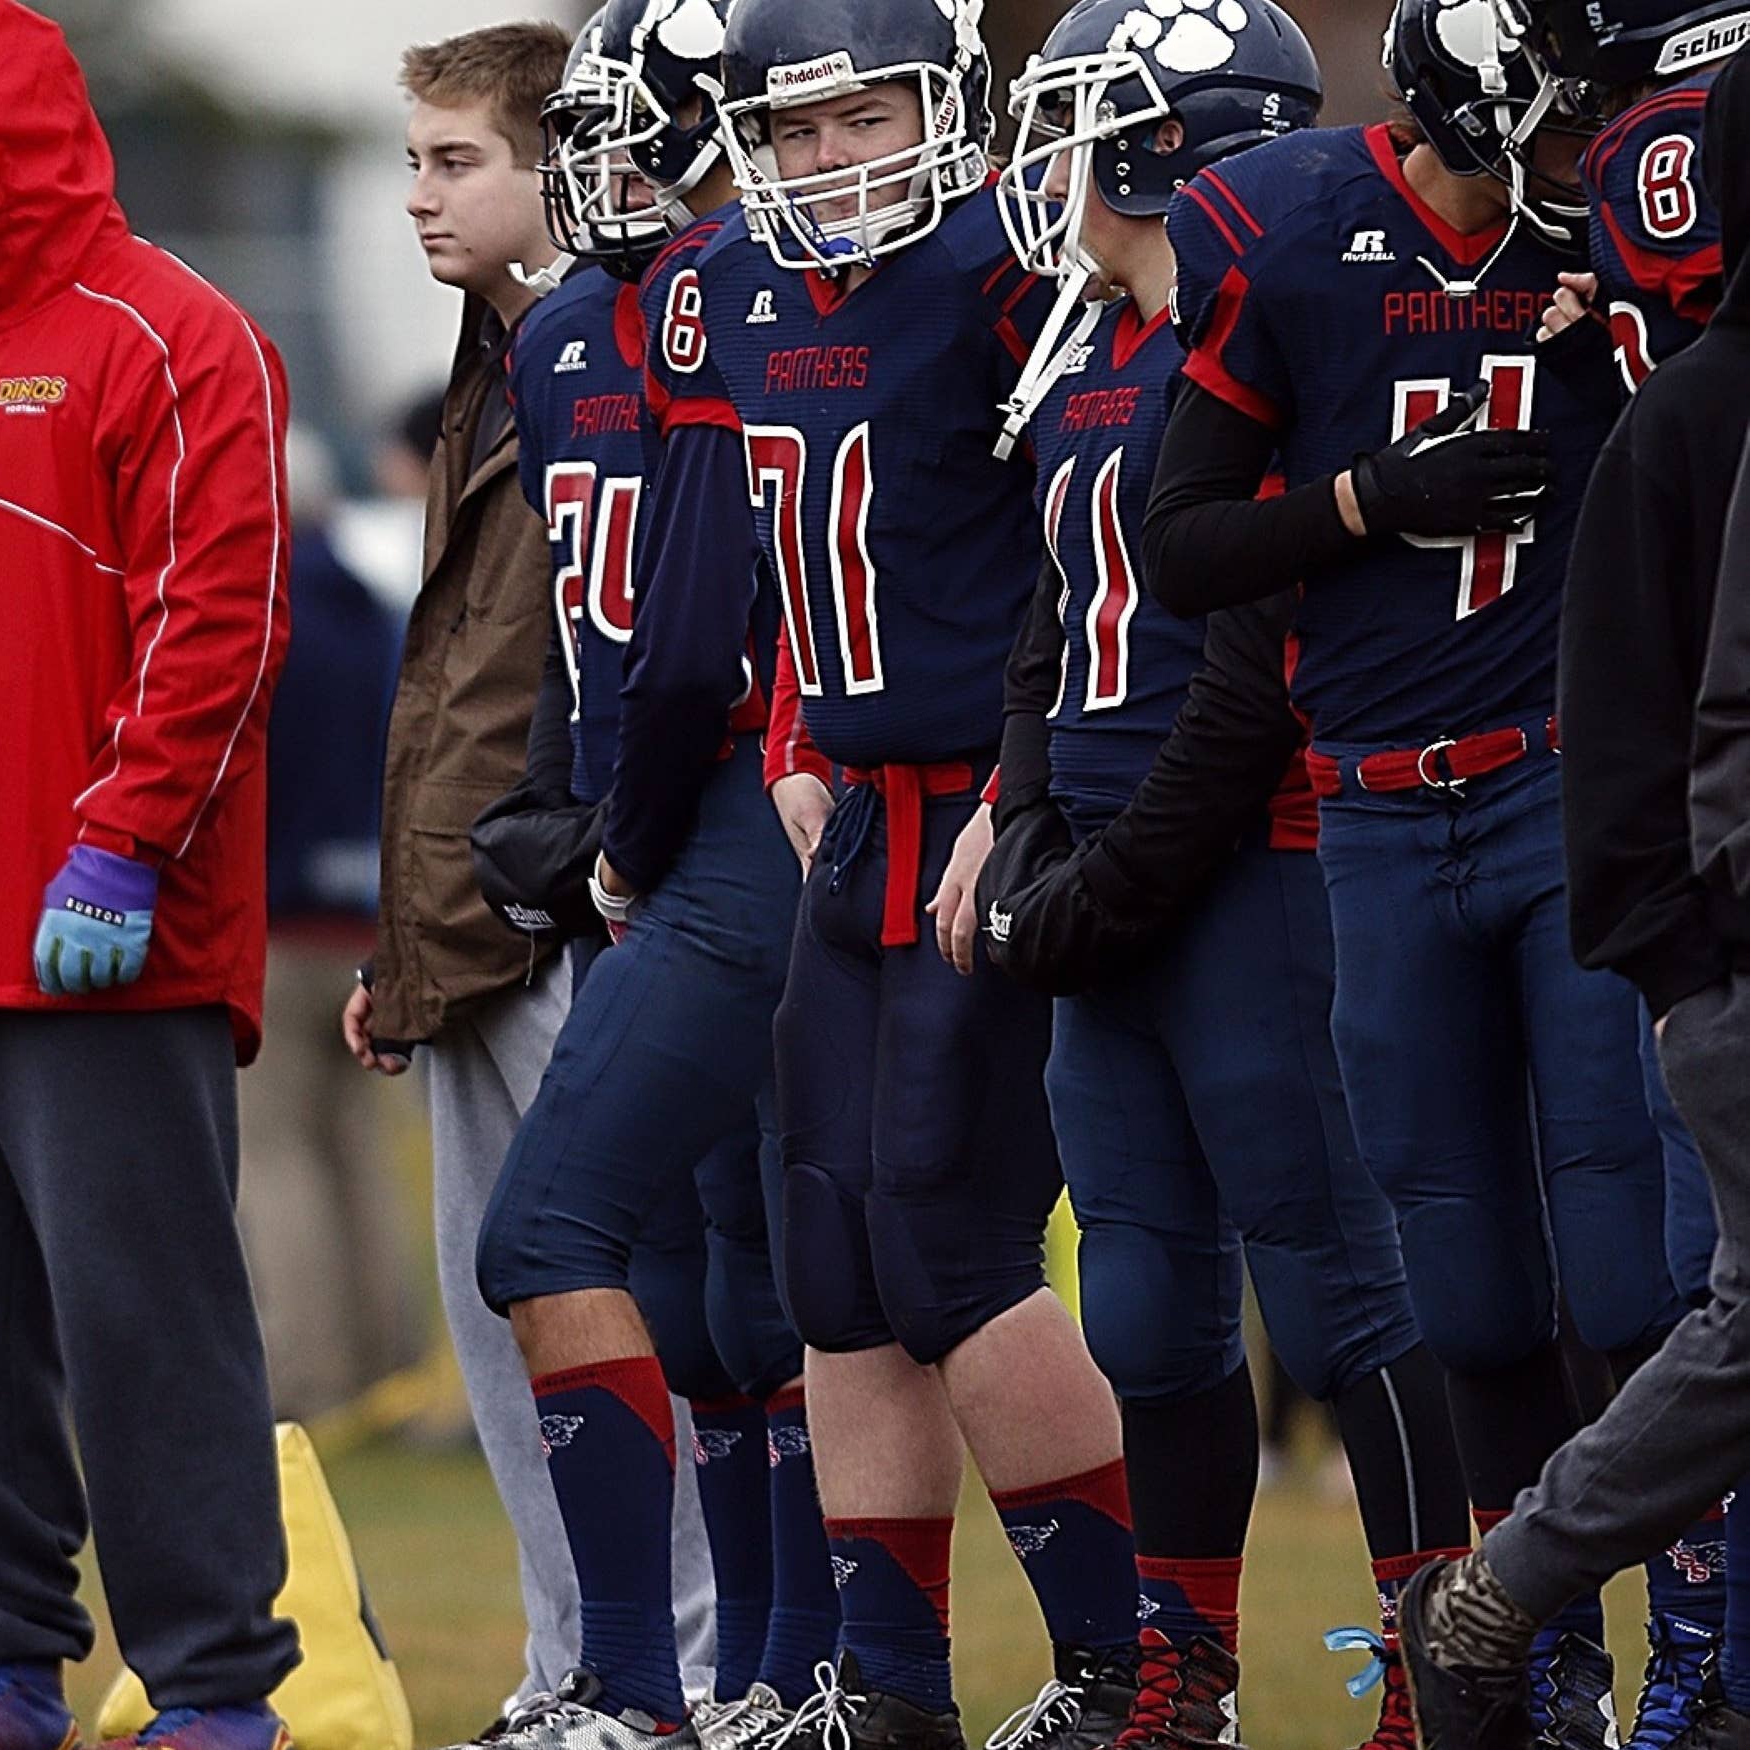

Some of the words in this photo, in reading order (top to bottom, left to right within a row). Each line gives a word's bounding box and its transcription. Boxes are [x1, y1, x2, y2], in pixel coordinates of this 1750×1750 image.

[1673, 22, 1748, 62] schut
[785, 62, 834, 86] Riddell
[1638, 134, 1698, 239] 8
[662, 269, 707, 374] 8
[764, 346, 869, 395] PANTHERS
[570, 393, 641, 439] PANTHE
[744, 421, 884, 696] 71
[65, 896, 124, 925] BURTON
